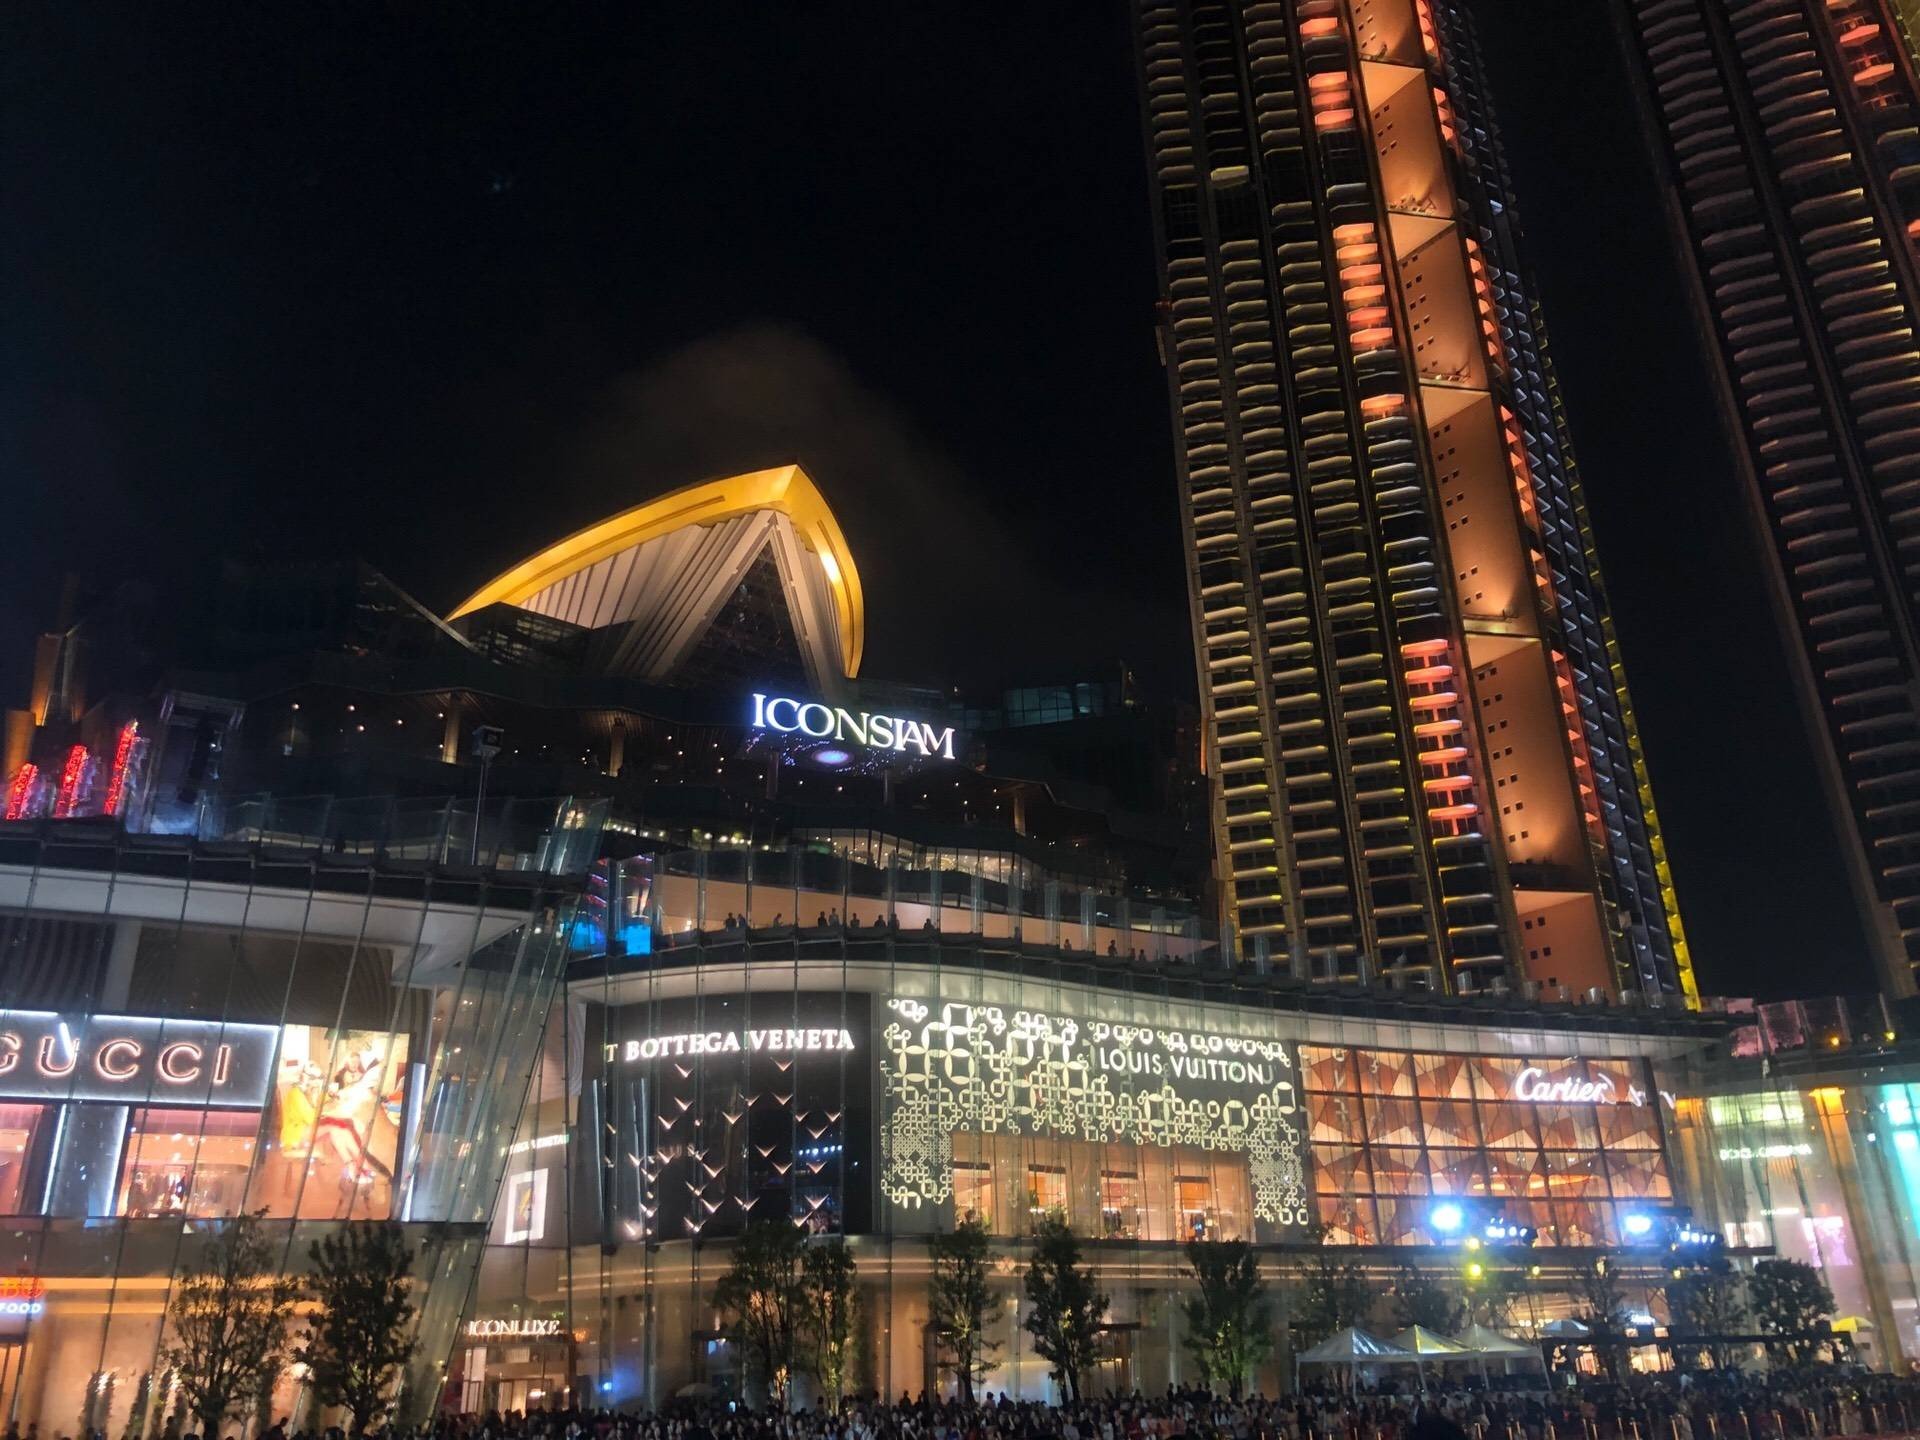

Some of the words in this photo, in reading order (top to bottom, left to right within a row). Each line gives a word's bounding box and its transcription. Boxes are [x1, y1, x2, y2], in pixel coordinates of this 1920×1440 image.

[753, 693, 956, 760] ICONSIAM
[625, 1031, 740, 1061] BOTTEGA
[748, 1029, 855, 1051] VENETA
[1100, 1047, 1163, 1075] LOUIS
[1170, 1054, 1264, 1085] VUITTON
[1515, 1067, 1608, 1102] Cartier
[469, 1319, 562, 1336] ICONLUXE
